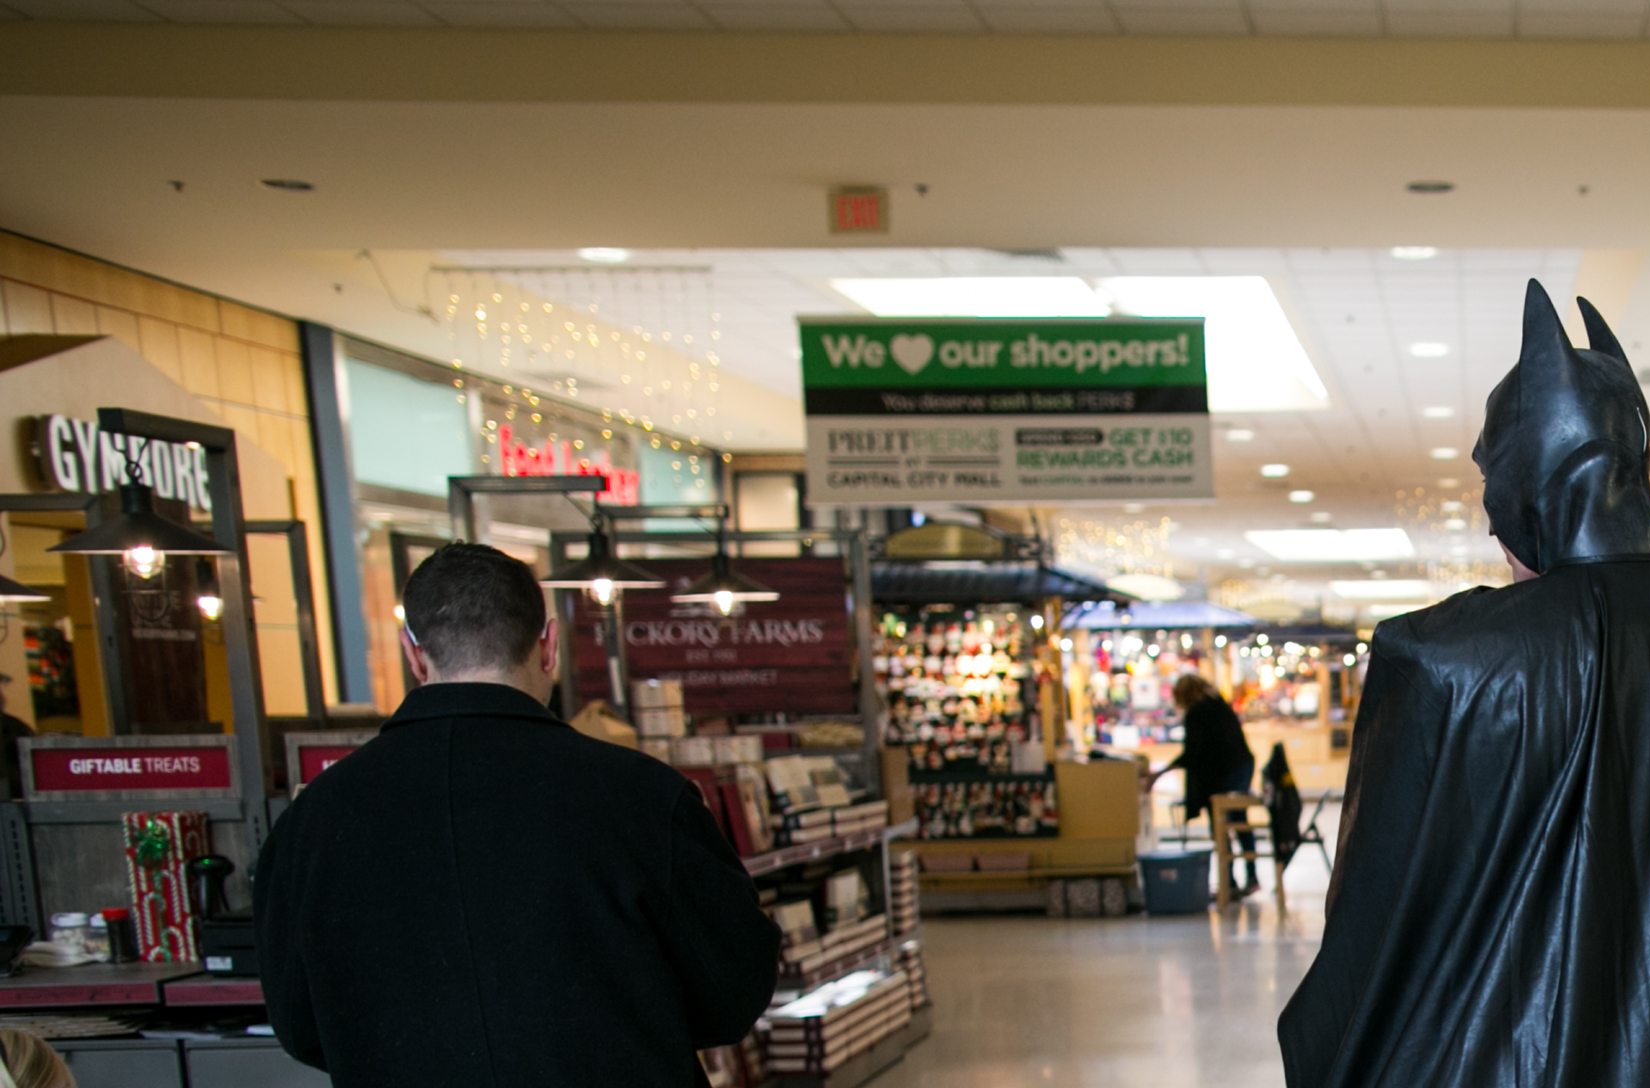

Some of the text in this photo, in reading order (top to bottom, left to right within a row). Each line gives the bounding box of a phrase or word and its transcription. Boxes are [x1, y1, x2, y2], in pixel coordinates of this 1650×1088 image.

[836, 195, 879, 229] EXIT
[821, 333, 1190, 373] We our shoppers!
[1108, 428, 1153, 447] GET
[49, 414, 213, 512] GYMBORE
[1016, 448, 1194, 469] REWARDS CASH
[827, 471, 901, 489] CAPITAL
[906, 471, 949, 488] CITY
[954, 471, 1001, 487] MALL
[593, 618, 823, 648] CKORY FARMS
[69, 757, 200, 774] GIFTABLE TREATS
